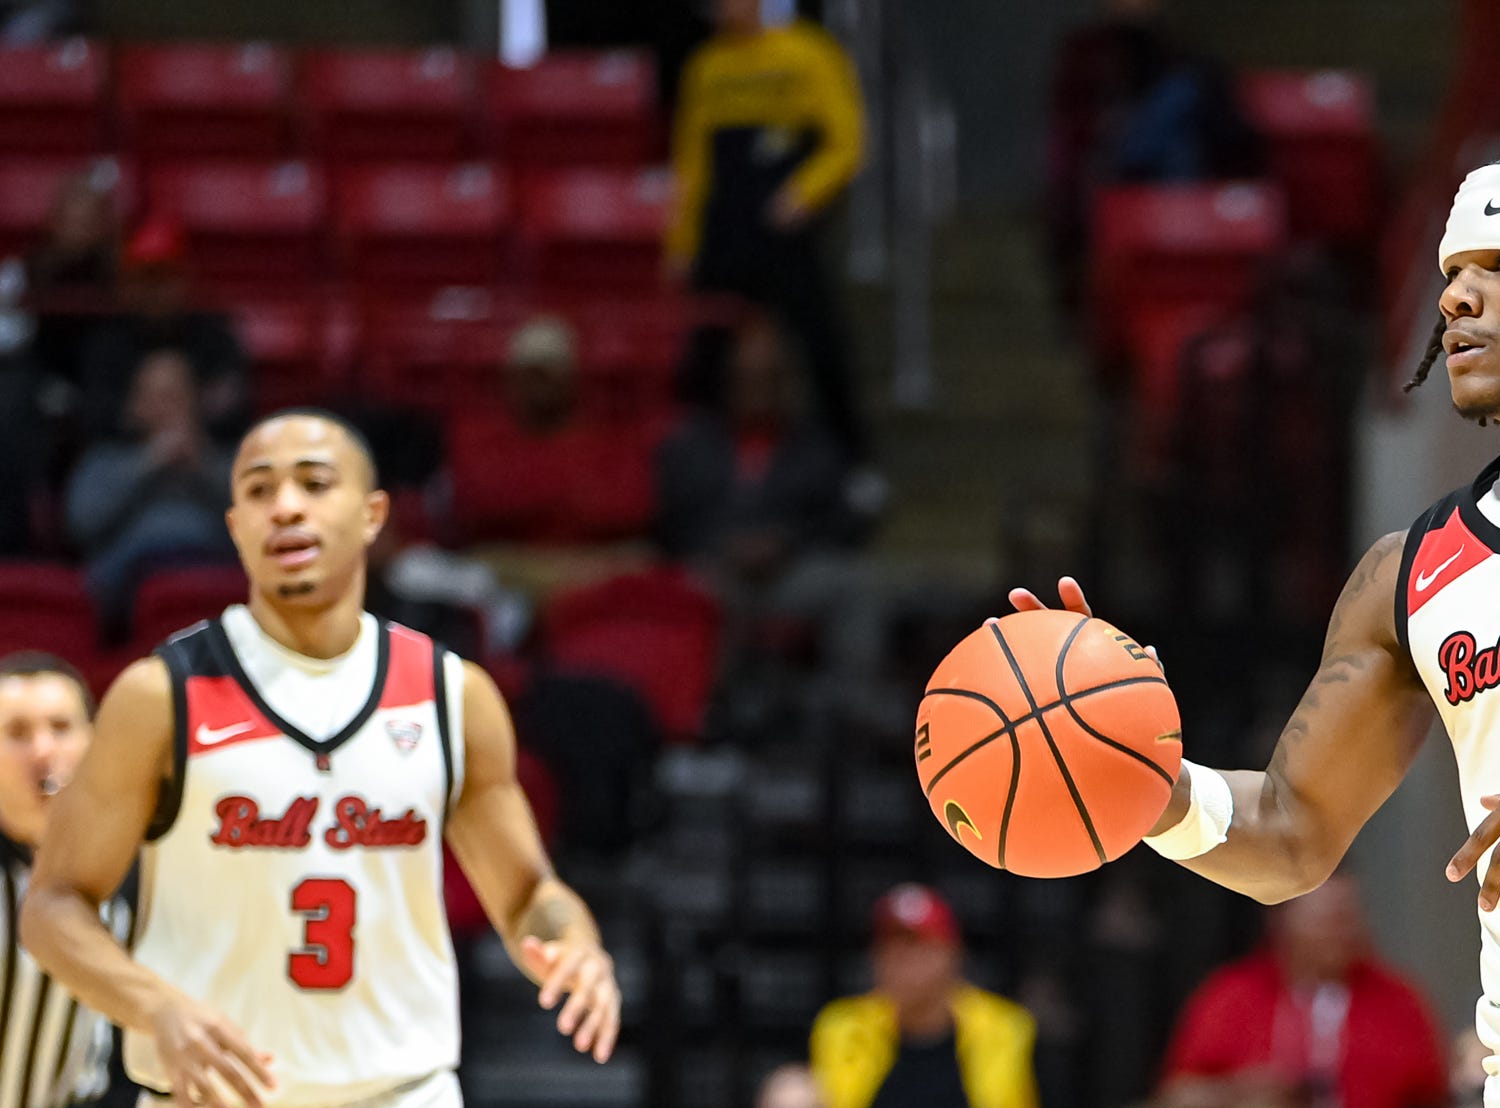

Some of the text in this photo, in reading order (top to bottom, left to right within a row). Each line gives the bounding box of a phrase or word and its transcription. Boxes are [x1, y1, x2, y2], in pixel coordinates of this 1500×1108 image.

[210, 794, 427, 849] Ball State
[286, 877, 357, 991] 3
